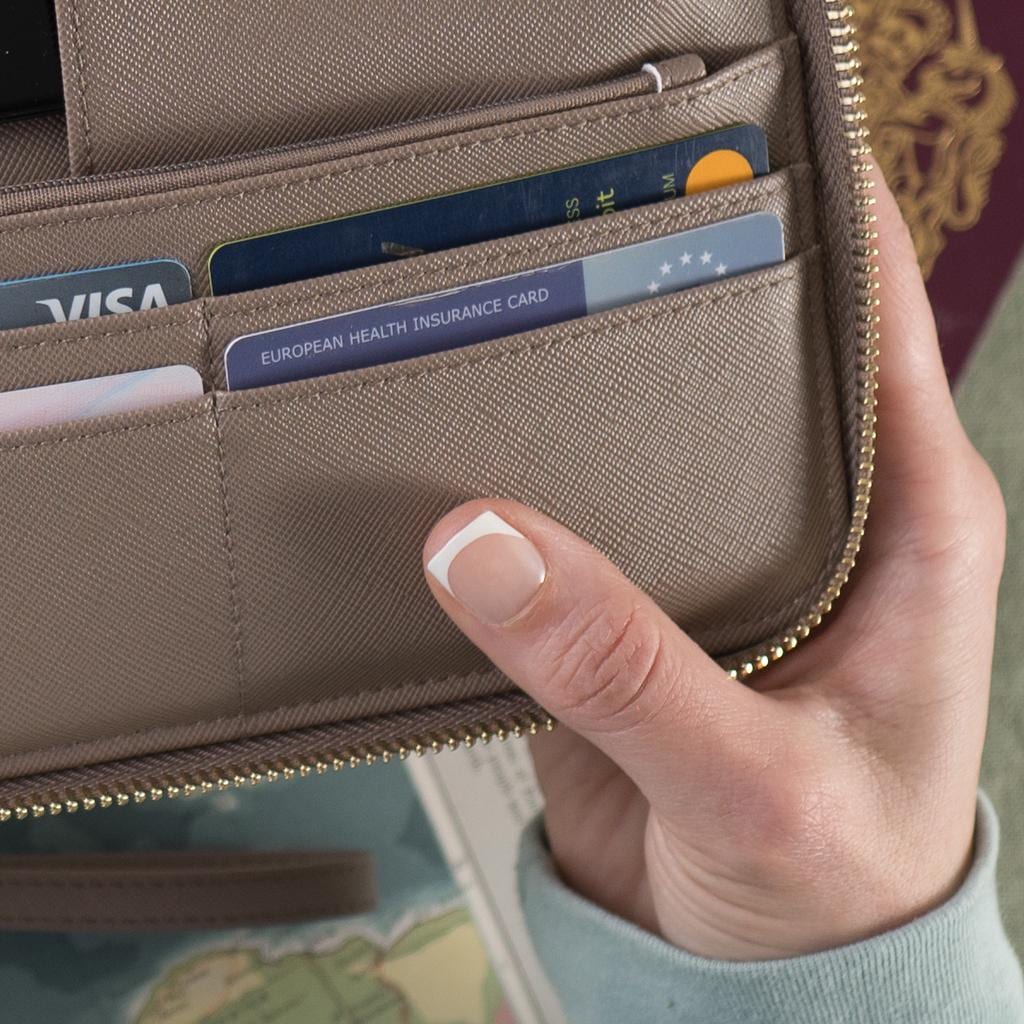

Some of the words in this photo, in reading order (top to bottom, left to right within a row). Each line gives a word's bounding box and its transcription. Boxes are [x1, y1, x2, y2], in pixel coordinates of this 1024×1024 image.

[35, 283, 169, 323] VISA
[260, 334, 344, 366] EUROPEAN
[349, 319, 408, 346] HEALTH
[413, 298, 503, 332] INSURANCE
[507, 287, 550, 310] CARD
